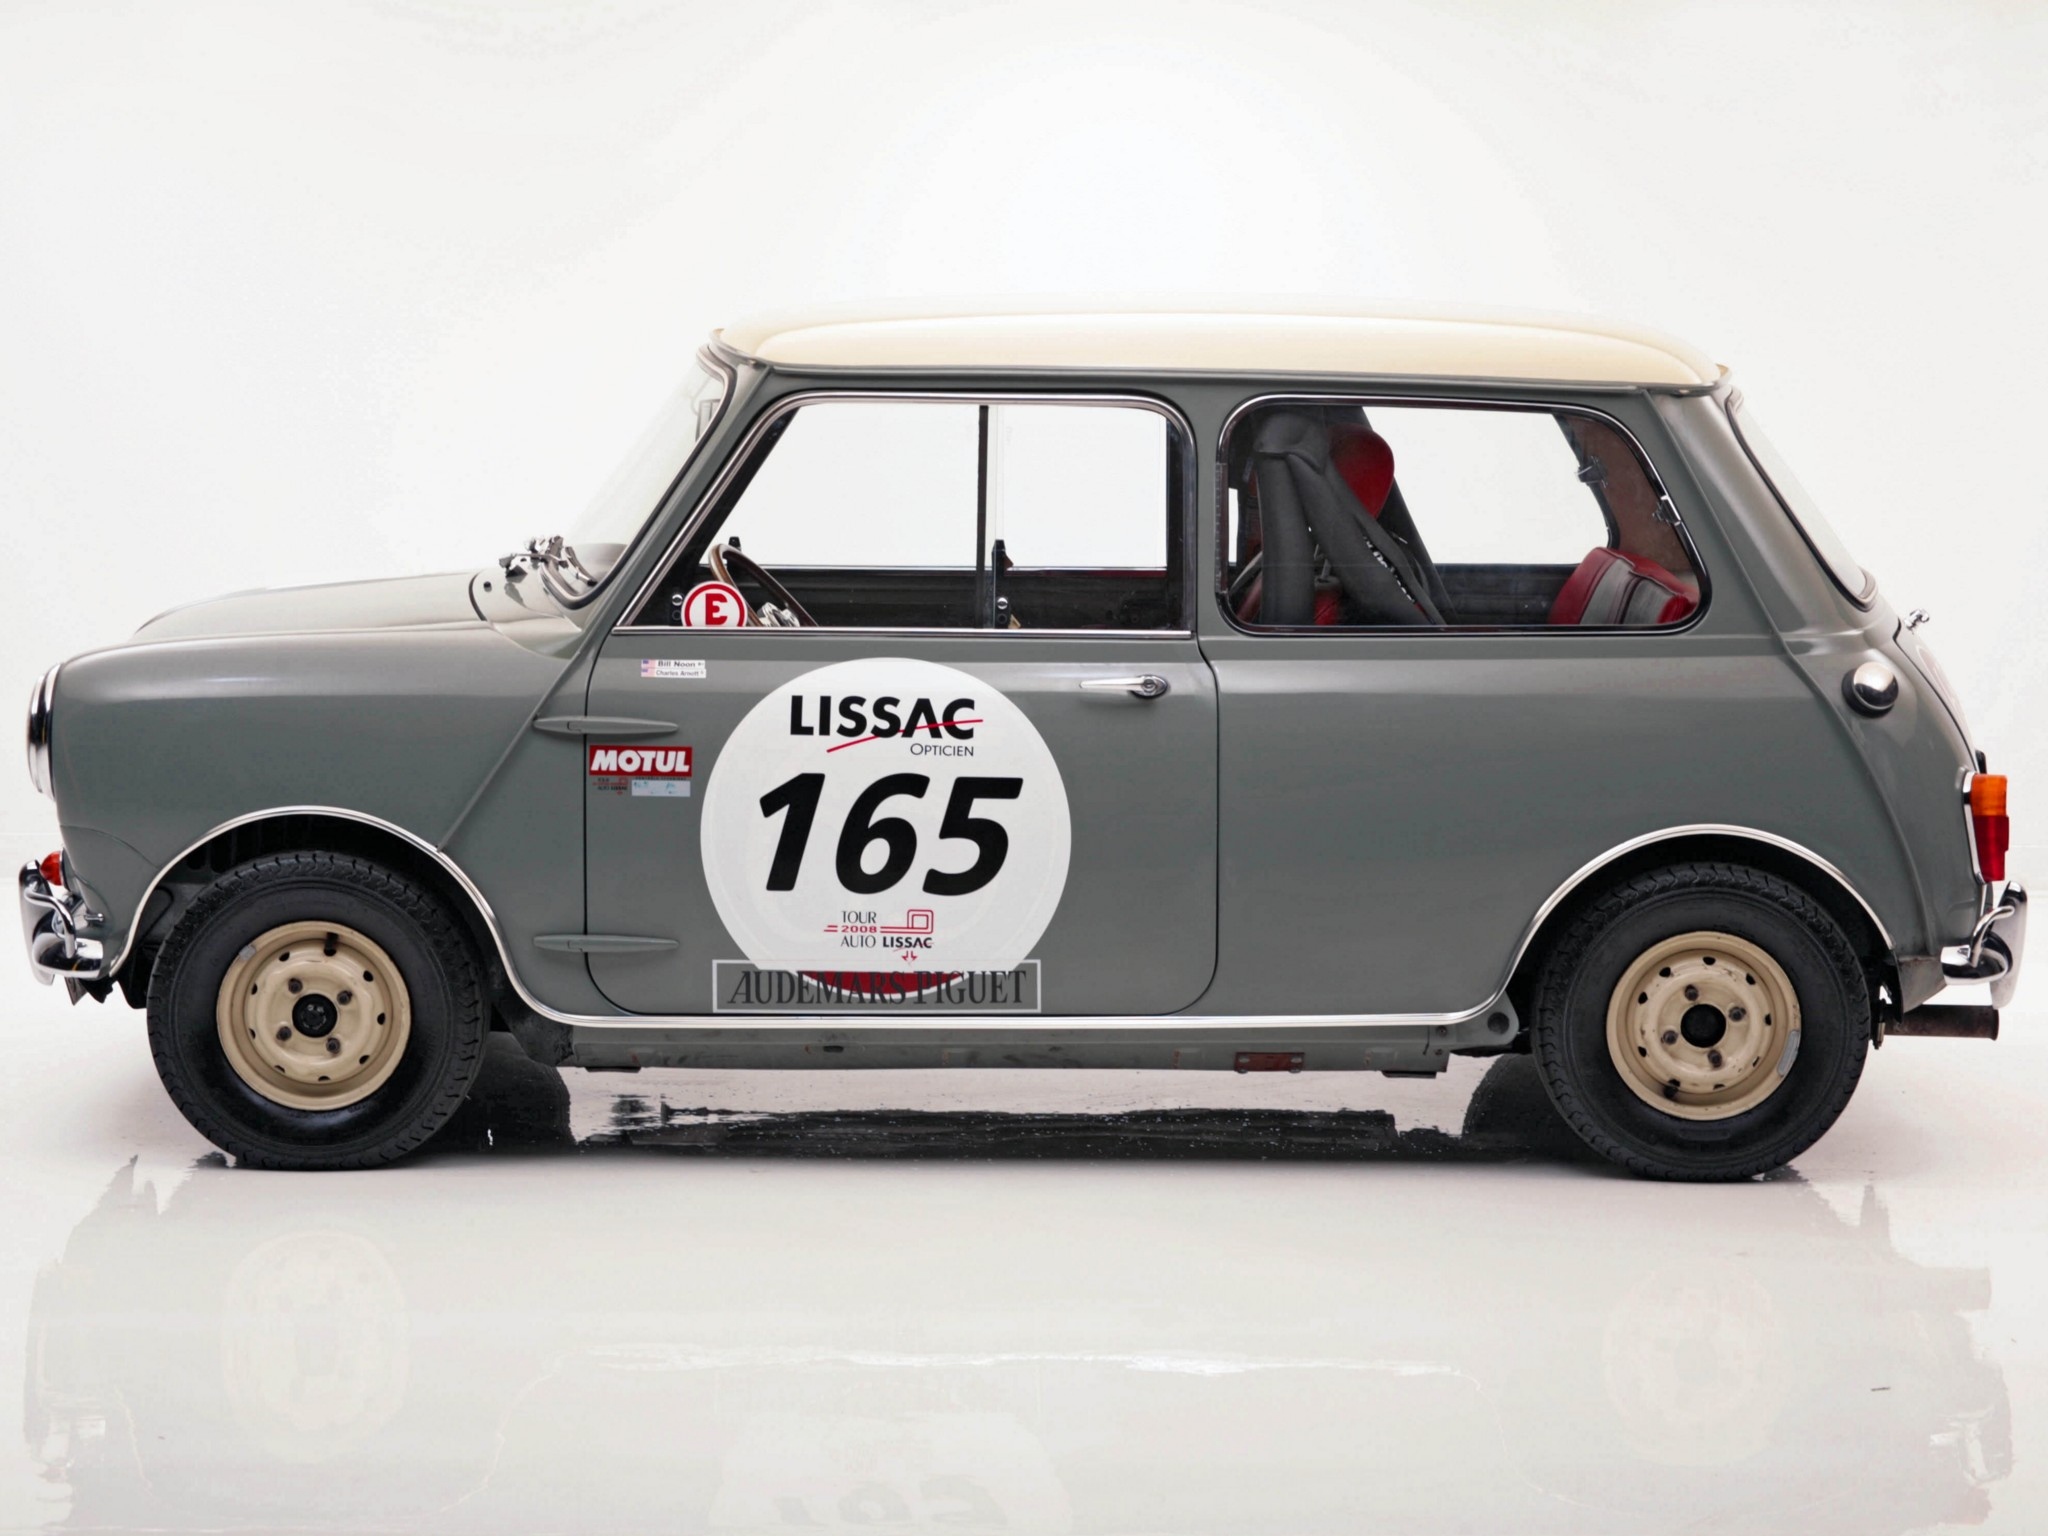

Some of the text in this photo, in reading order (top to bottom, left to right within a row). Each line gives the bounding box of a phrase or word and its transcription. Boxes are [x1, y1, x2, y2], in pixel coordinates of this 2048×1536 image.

[705, 593, 728, 625] E
[790, 695, 976, 740] LISSAC
[590, 749, 690, 773] MOTUL
[910, 743, 975, 757] OPTICIEN
[759, 772, 1024, 896] 165
[841, 910, 877, 924] TOUR
[841, 925, 877, 933] 2008
[840, 935, 933, 949] AUTO LISSAC
[727, 969, 1027, 1005] AUDEMARS PIGUET
